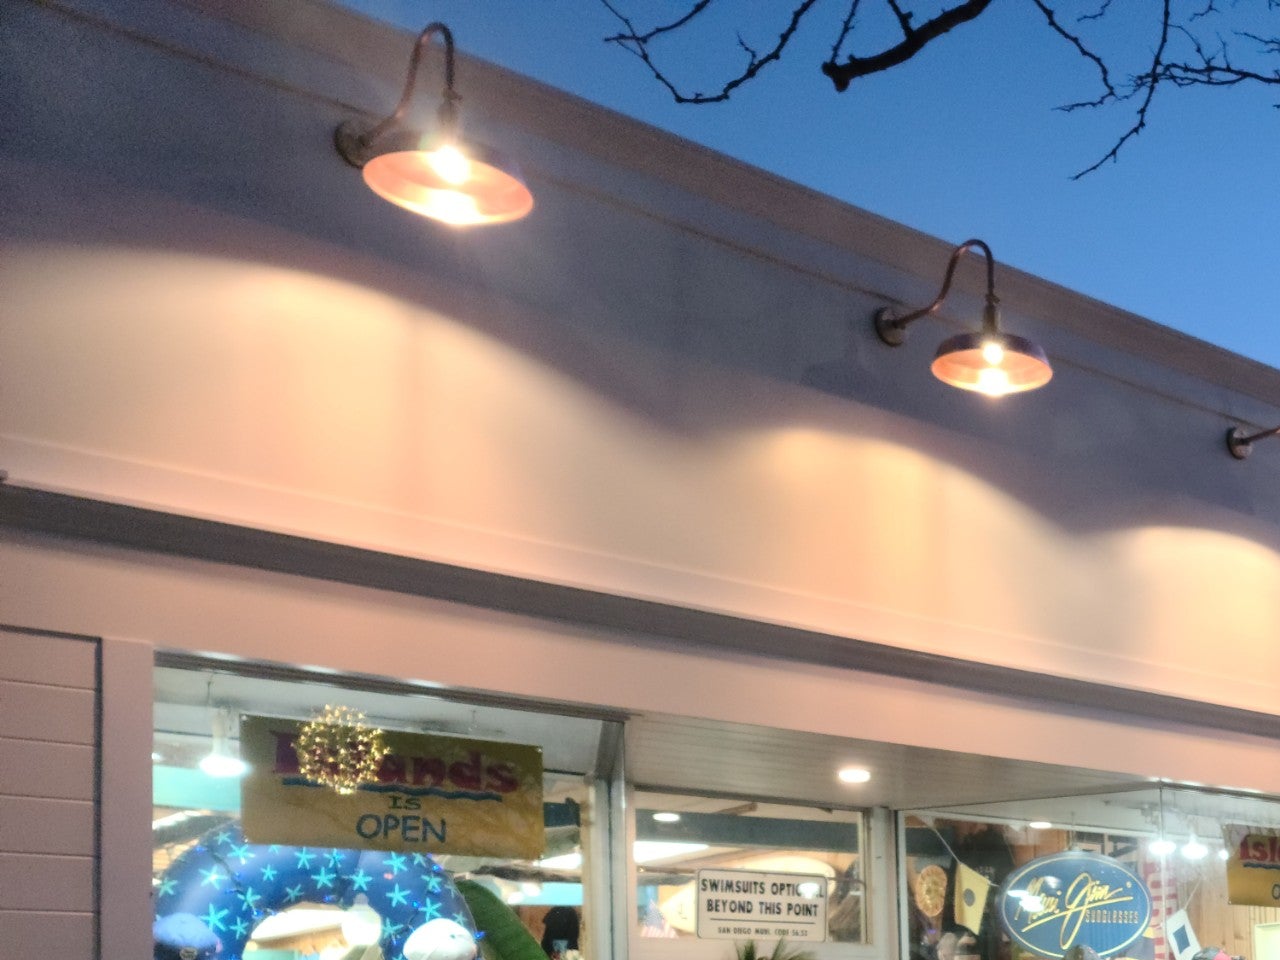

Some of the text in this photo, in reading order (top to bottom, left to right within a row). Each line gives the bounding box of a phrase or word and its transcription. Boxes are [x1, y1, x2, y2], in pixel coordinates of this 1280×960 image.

[388, 796, 421, 810] IS
[356, 813, 447, 844] OPEN
[700, 879, 765, 894] SWIMSUITS
[707, 899, 819, 916] BEYOND THIS POINT
[1085, 910, 1139, 923] SUNGLASSES
